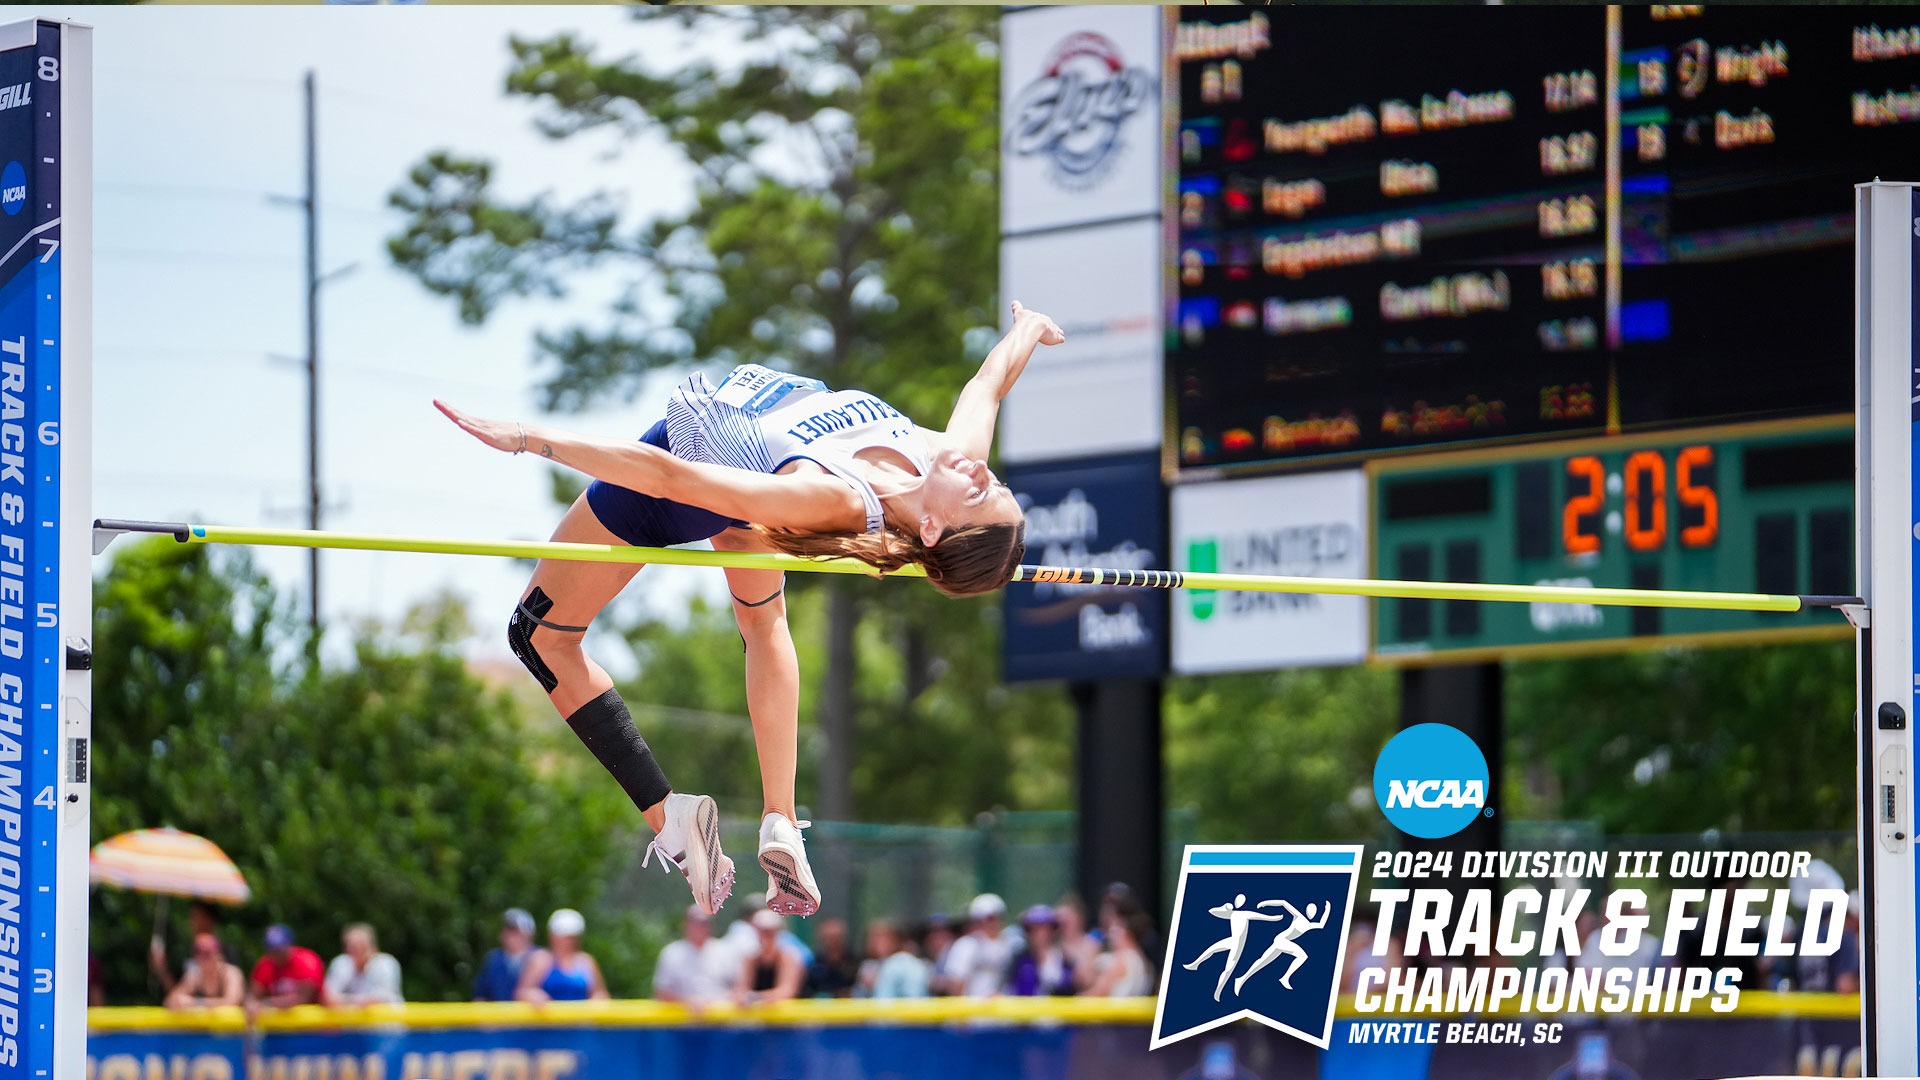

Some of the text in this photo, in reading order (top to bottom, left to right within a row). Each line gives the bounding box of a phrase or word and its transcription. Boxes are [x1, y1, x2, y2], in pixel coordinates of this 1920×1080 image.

[38, 55, 60, 82] 8
[0, 82, 32, 111] GILL
[2, 185, 27, 204] NCAA
[39, 238, 60, 263] 7
[38, 421, 60, 446] 6
[1562, 445, 1719, 555] 2:05
[1225, 522, 1353, 567] UNITED
[1032, 566, 1083, 583] GILL
[36, 602, 58, 627] 5
[0, 335, 26, 1068] TRACK & FIELD CHAMPIONSHIPS
[33, 785, 57, 811] 4
[33, 968, 53, 993] 3
